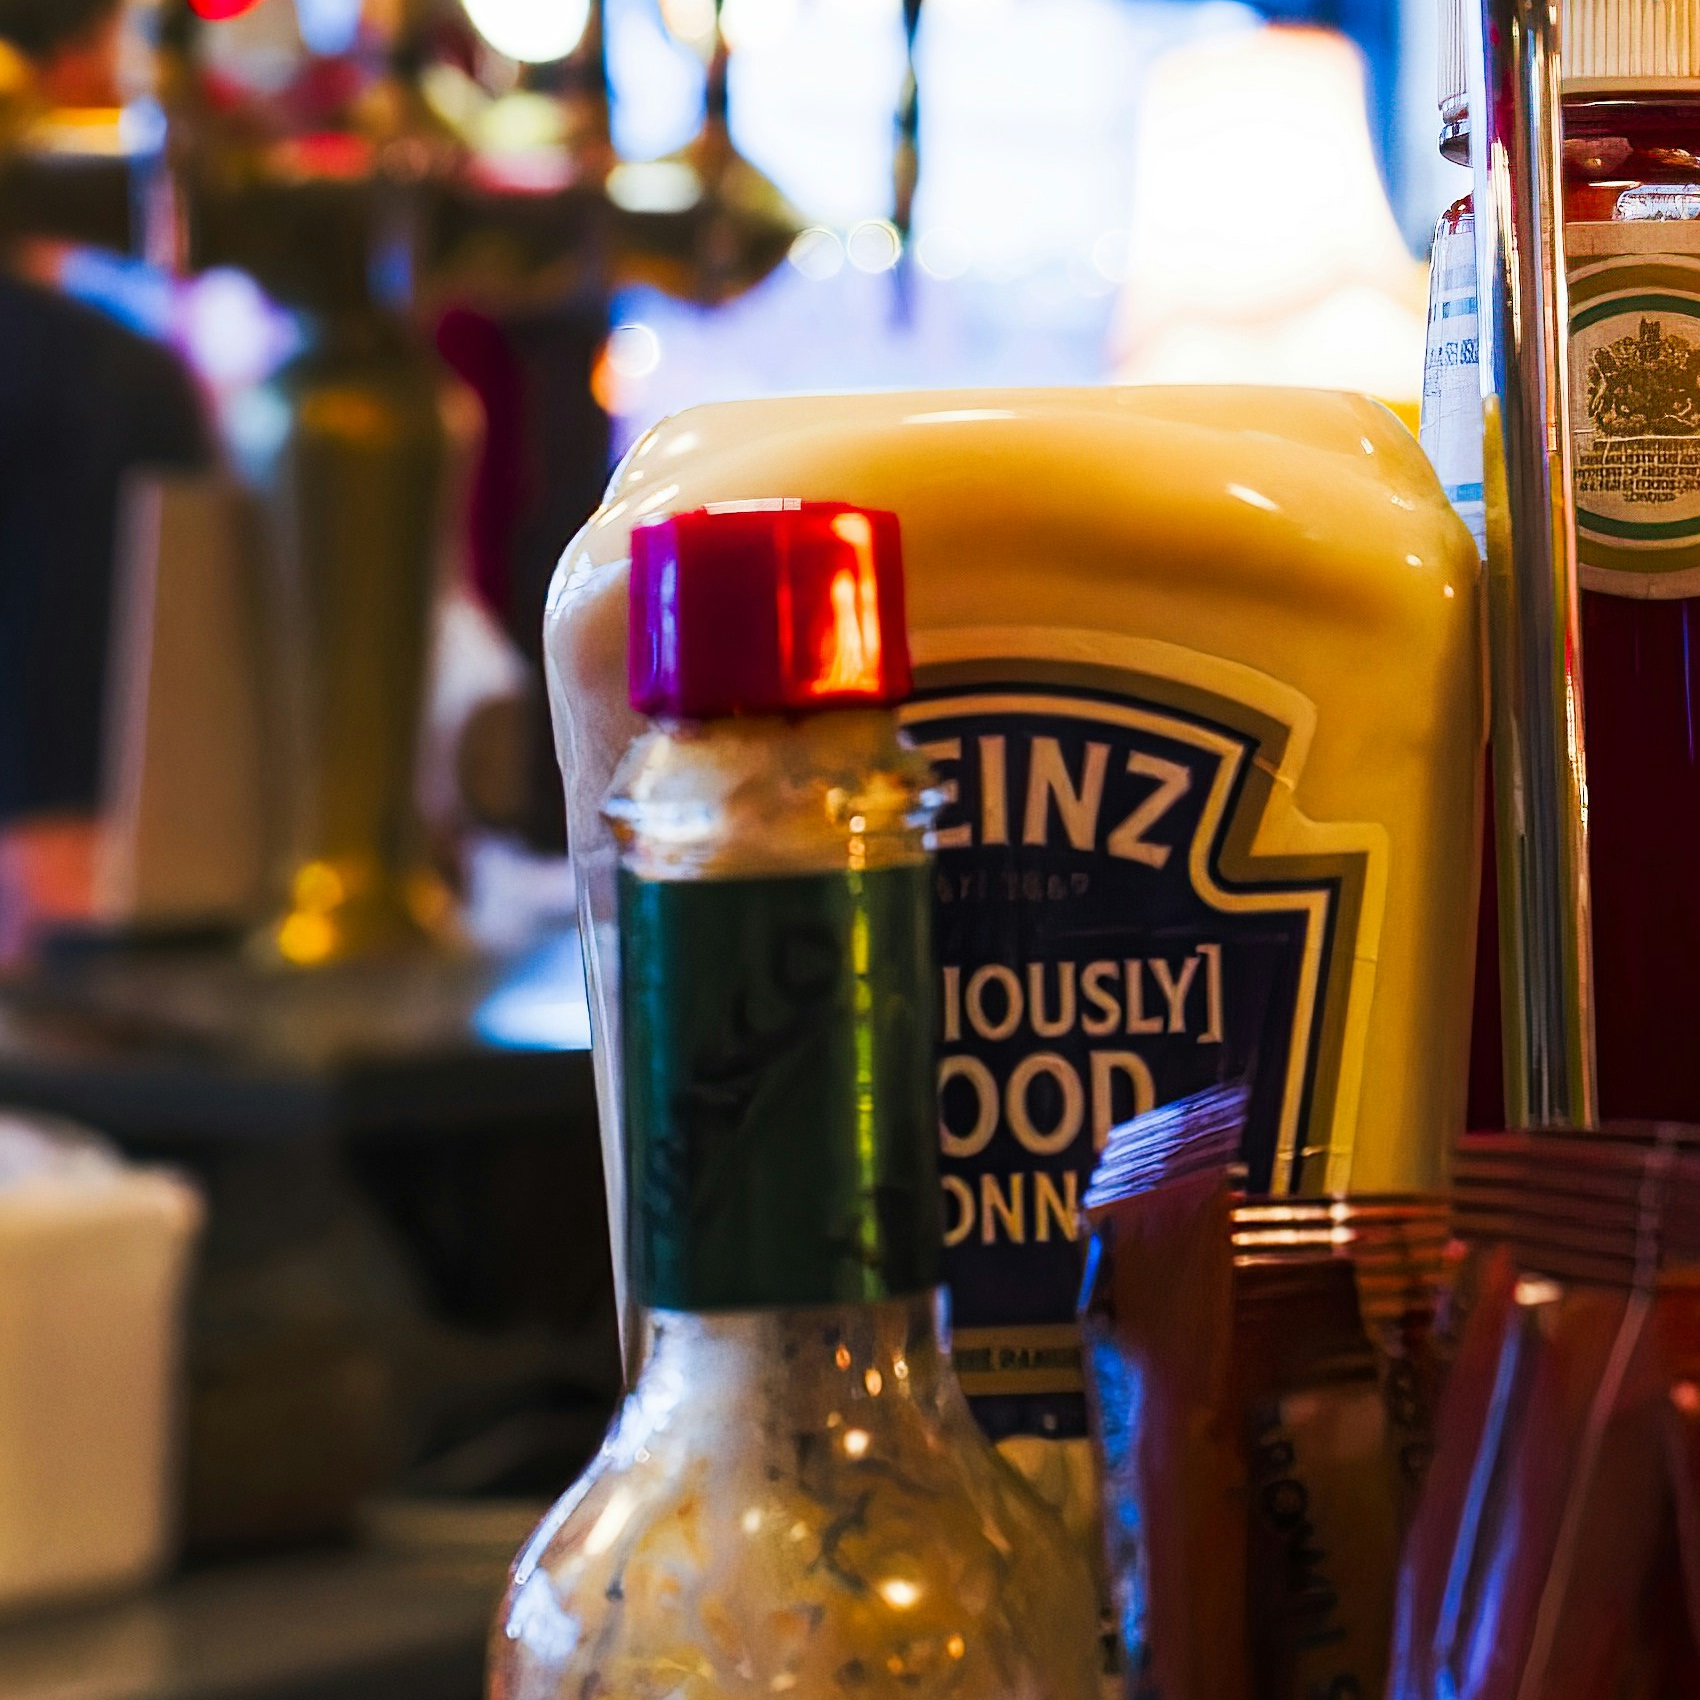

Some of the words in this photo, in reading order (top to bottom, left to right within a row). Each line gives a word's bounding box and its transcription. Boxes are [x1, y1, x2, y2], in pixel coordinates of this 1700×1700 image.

[921, 735, 1191, 870] EINZ
[943, 943, 1223, 1044] IOUSLY]
[938, 1050, 1156, 1158] OOD
[941, 1169, 1080, 1246] ONN
